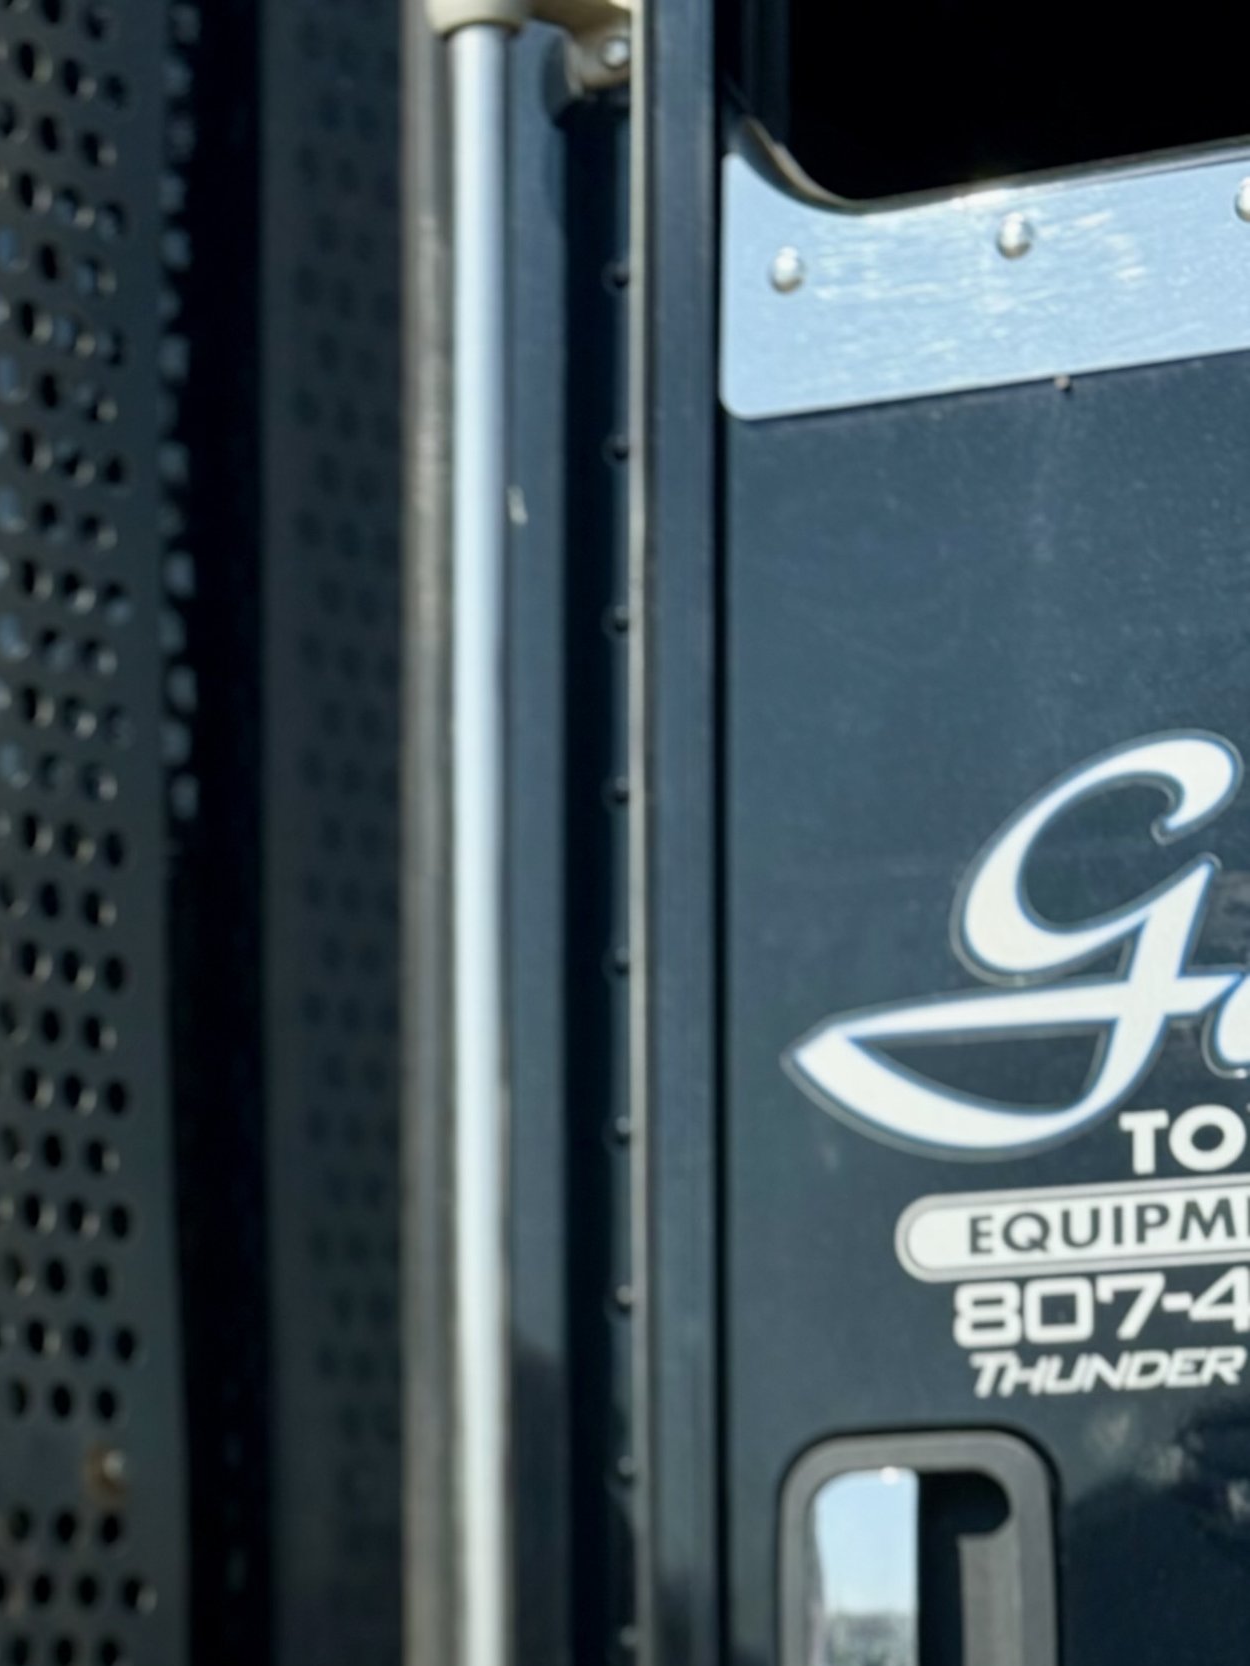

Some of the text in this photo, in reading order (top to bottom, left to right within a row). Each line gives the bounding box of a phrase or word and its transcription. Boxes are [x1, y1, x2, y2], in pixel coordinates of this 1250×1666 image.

[1119, 1104, 1250, 1175] TO
[968, 1196, 1250, 1256] EQUIPM
[969, 1347, 1247, 1399] THUNDER
